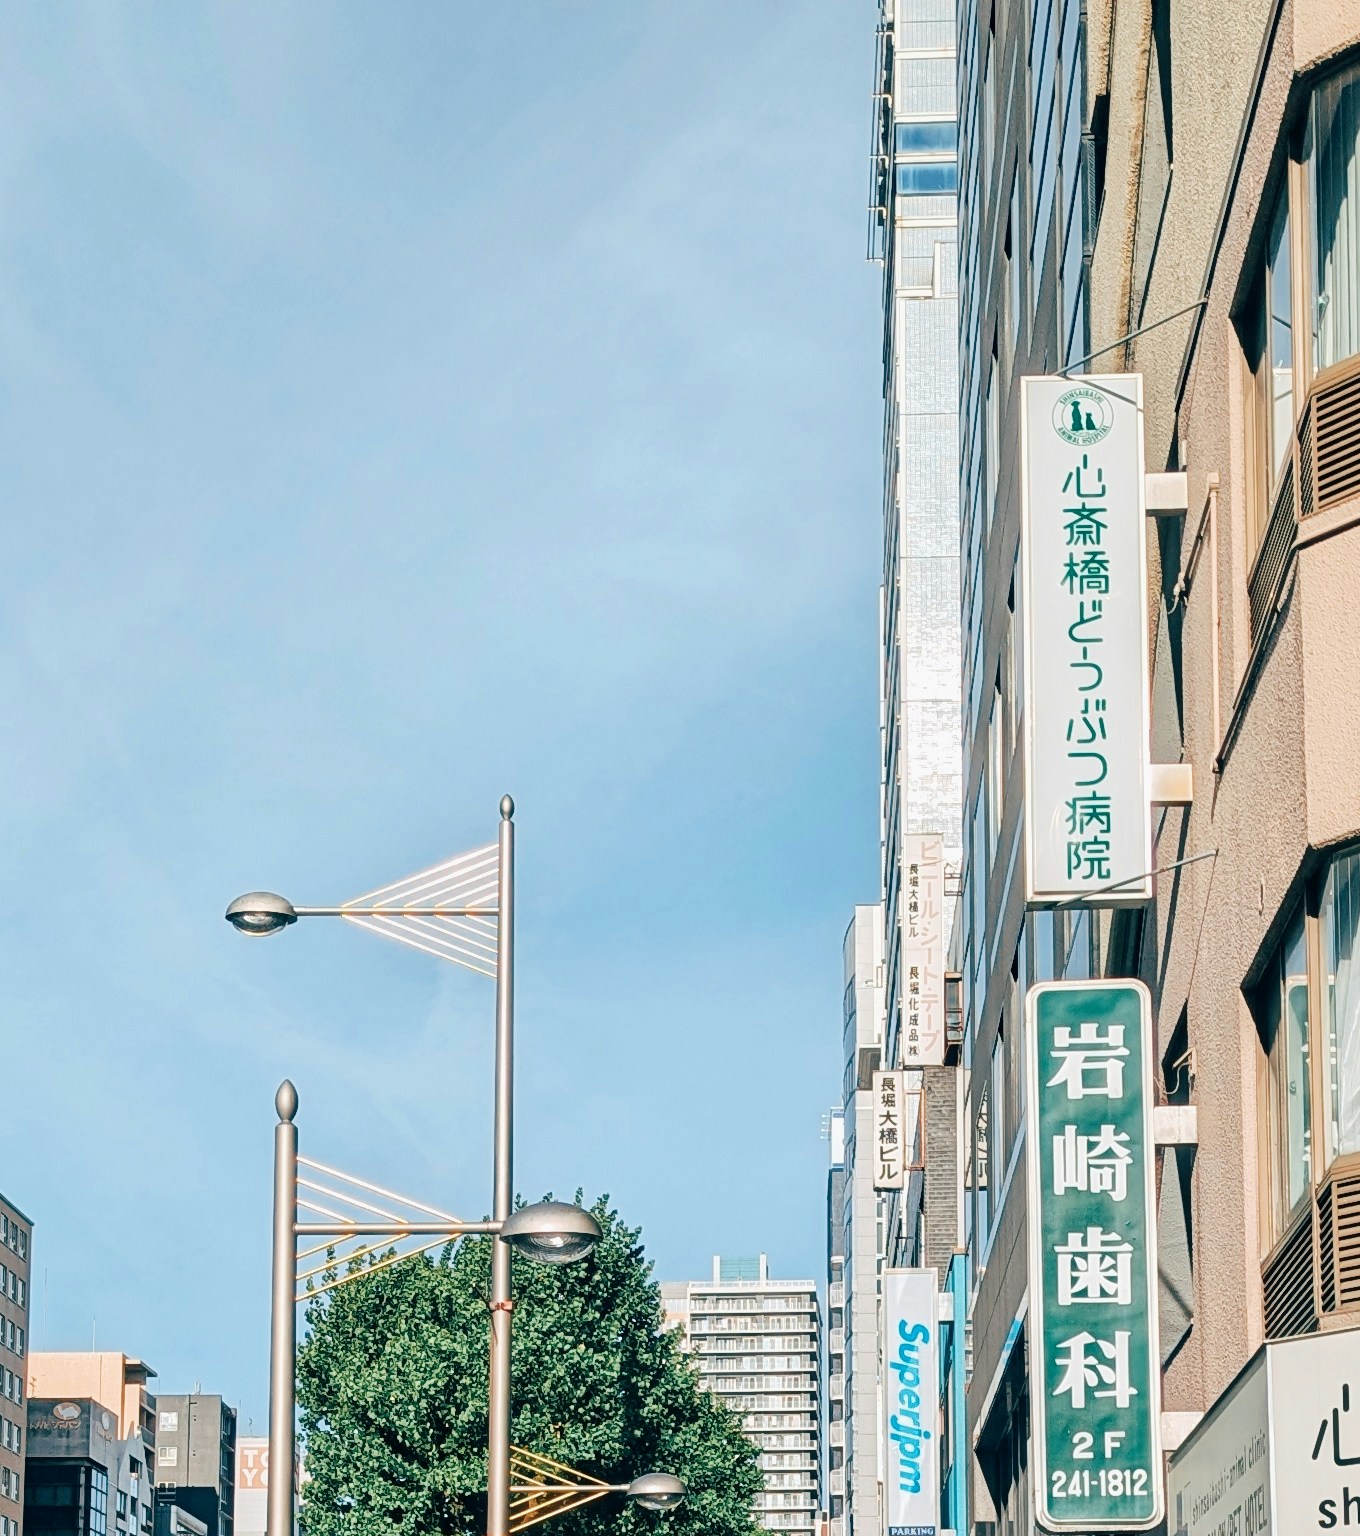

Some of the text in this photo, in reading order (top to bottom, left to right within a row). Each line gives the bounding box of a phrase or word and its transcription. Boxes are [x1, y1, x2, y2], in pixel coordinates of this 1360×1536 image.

[1060, 389, 1105, 404] SHINSAIBASHI
[1058, 425, 1111, 444] ANIMAL HOSPITAL
[1061, 454, 1112, 881] 心斎橋どうぶつ病院
[879, 1078, 899, 1180] 長堀大橋ビル
[1046, 1022, 1138, 1409] 岩崎歯科
[890, 1318, 932, 1495] Superjpm
[1072, 1430, 1126, 1460] 2F
[1051, 1467, 1148, 1499] 241-1812
[891, 1528, 934, 1536] PARKING
